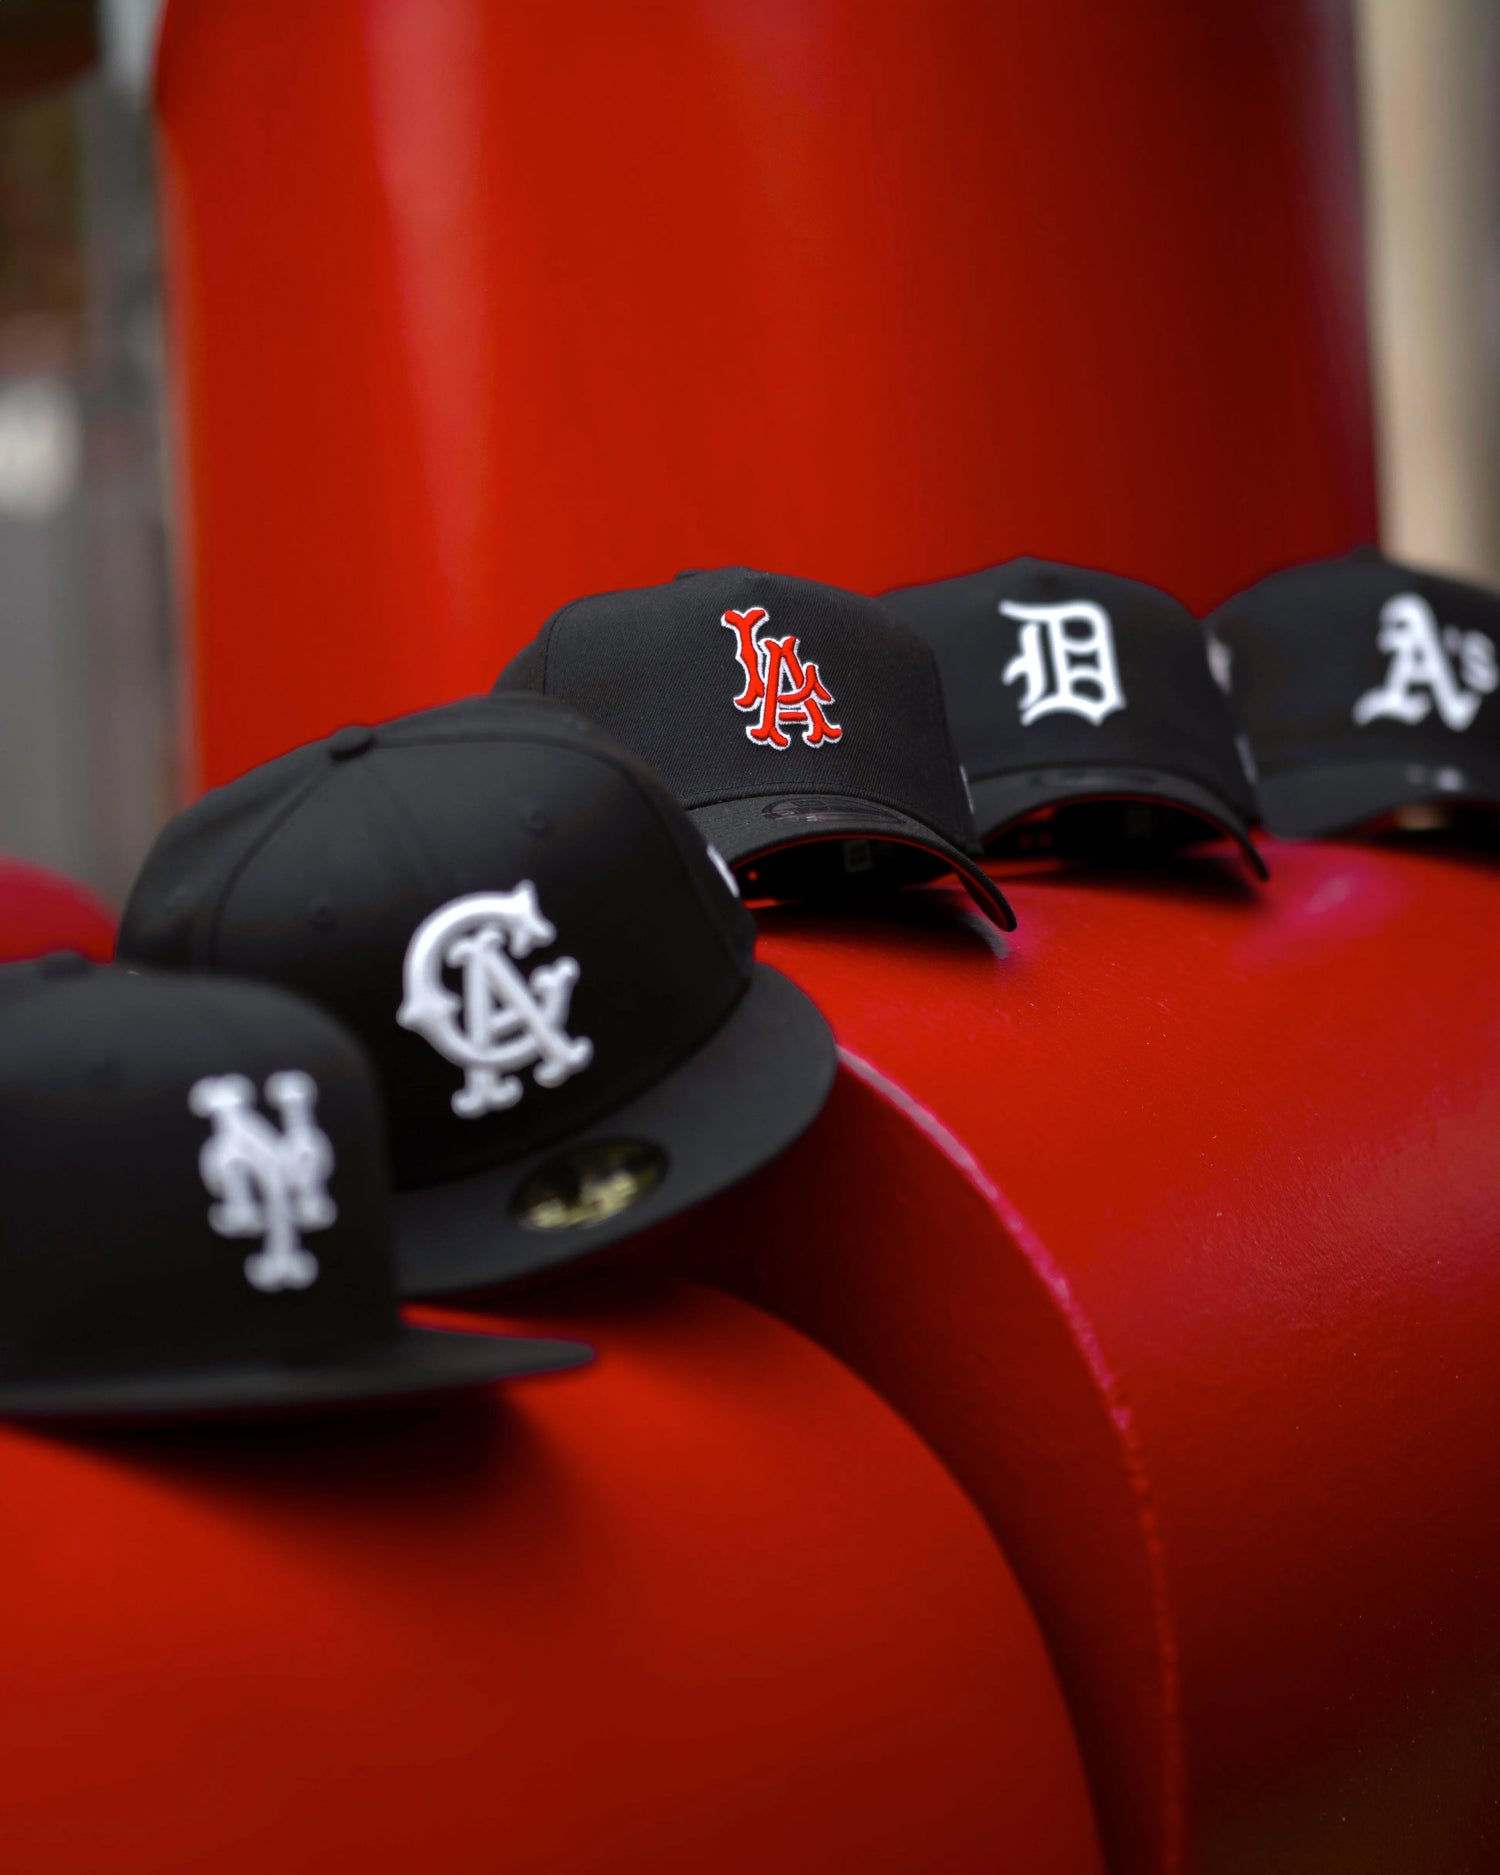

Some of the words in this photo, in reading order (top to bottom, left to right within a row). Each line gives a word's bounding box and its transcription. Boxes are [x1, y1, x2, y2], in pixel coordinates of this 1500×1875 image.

[720, 606, 843, 750] LA
[999, 599, 1126, 726] D
[188, 1070, 338, 1293] NY
